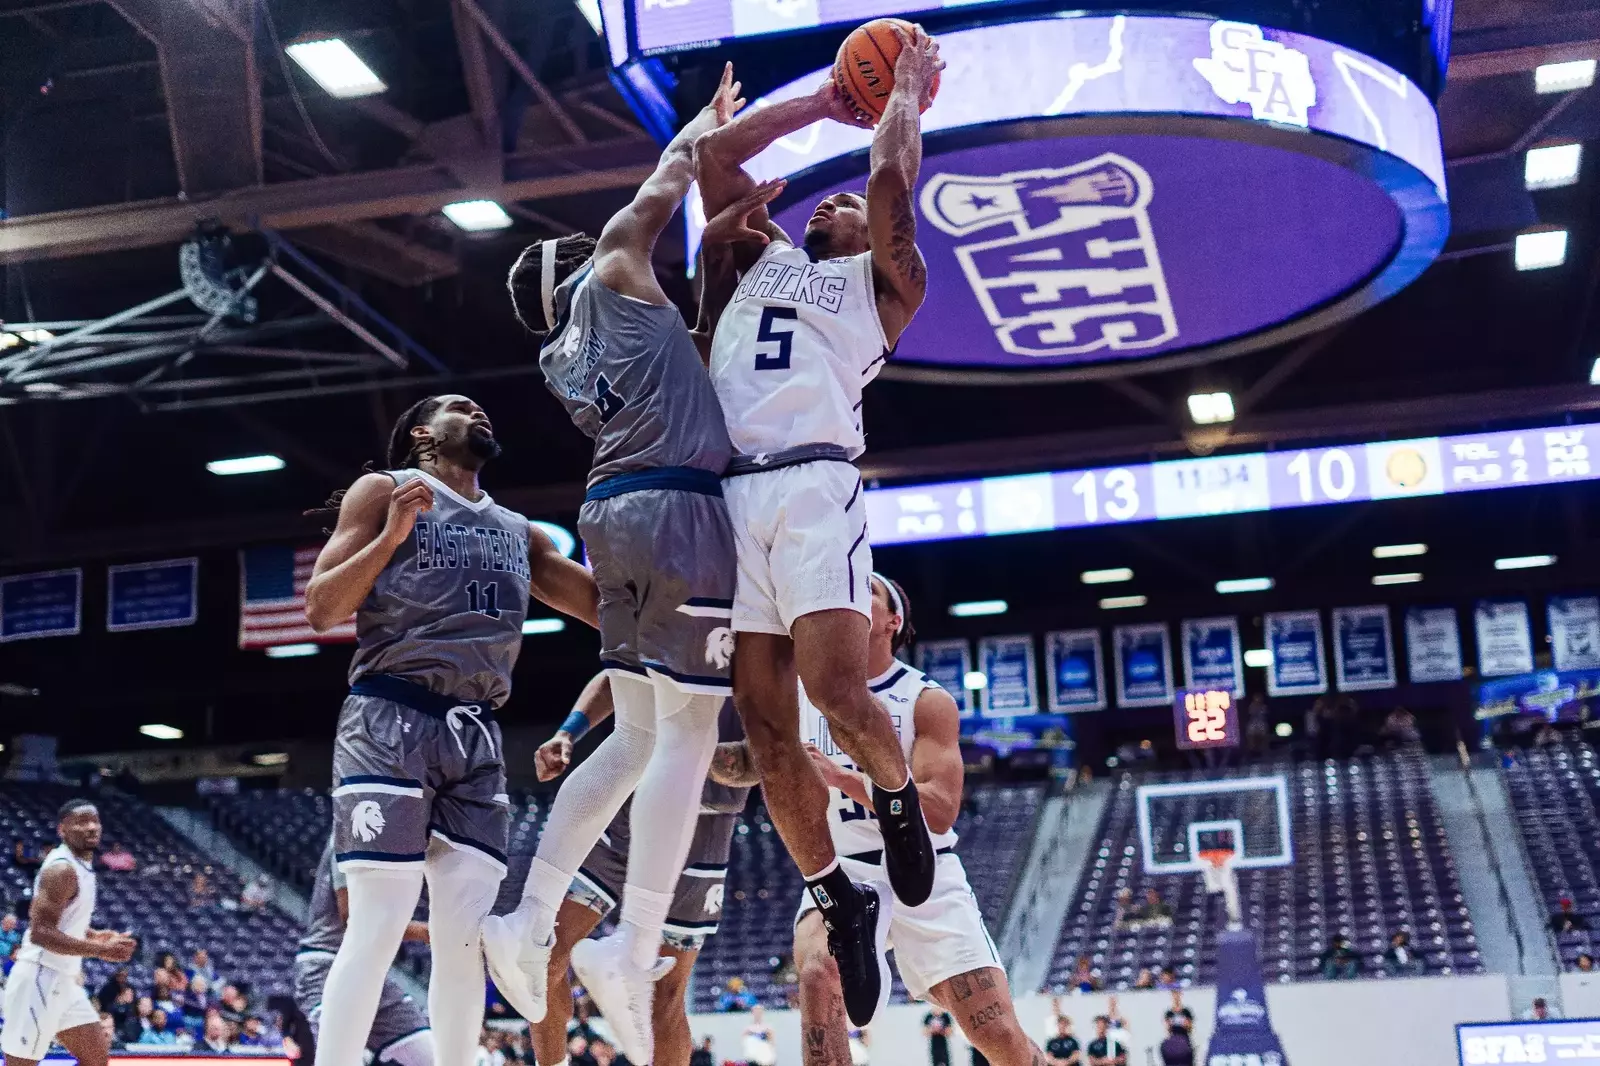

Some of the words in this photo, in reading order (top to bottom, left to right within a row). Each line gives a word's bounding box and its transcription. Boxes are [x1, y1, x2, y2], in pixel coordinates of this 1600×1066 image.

[1221, 27, 1299, 118] SFA
[735, 260, 847, 314] JACKS
[754, 305, 799, 371] 5
[1072, 467, 1140, 523] 13
[1286, 447, 1357, 504] 10
[1510, 458, 1529, 482] 2
[415, 521, 470, 571] EAST
[465, 580, 502, 621] 11
[1187, 707, 1227, 742] 22
